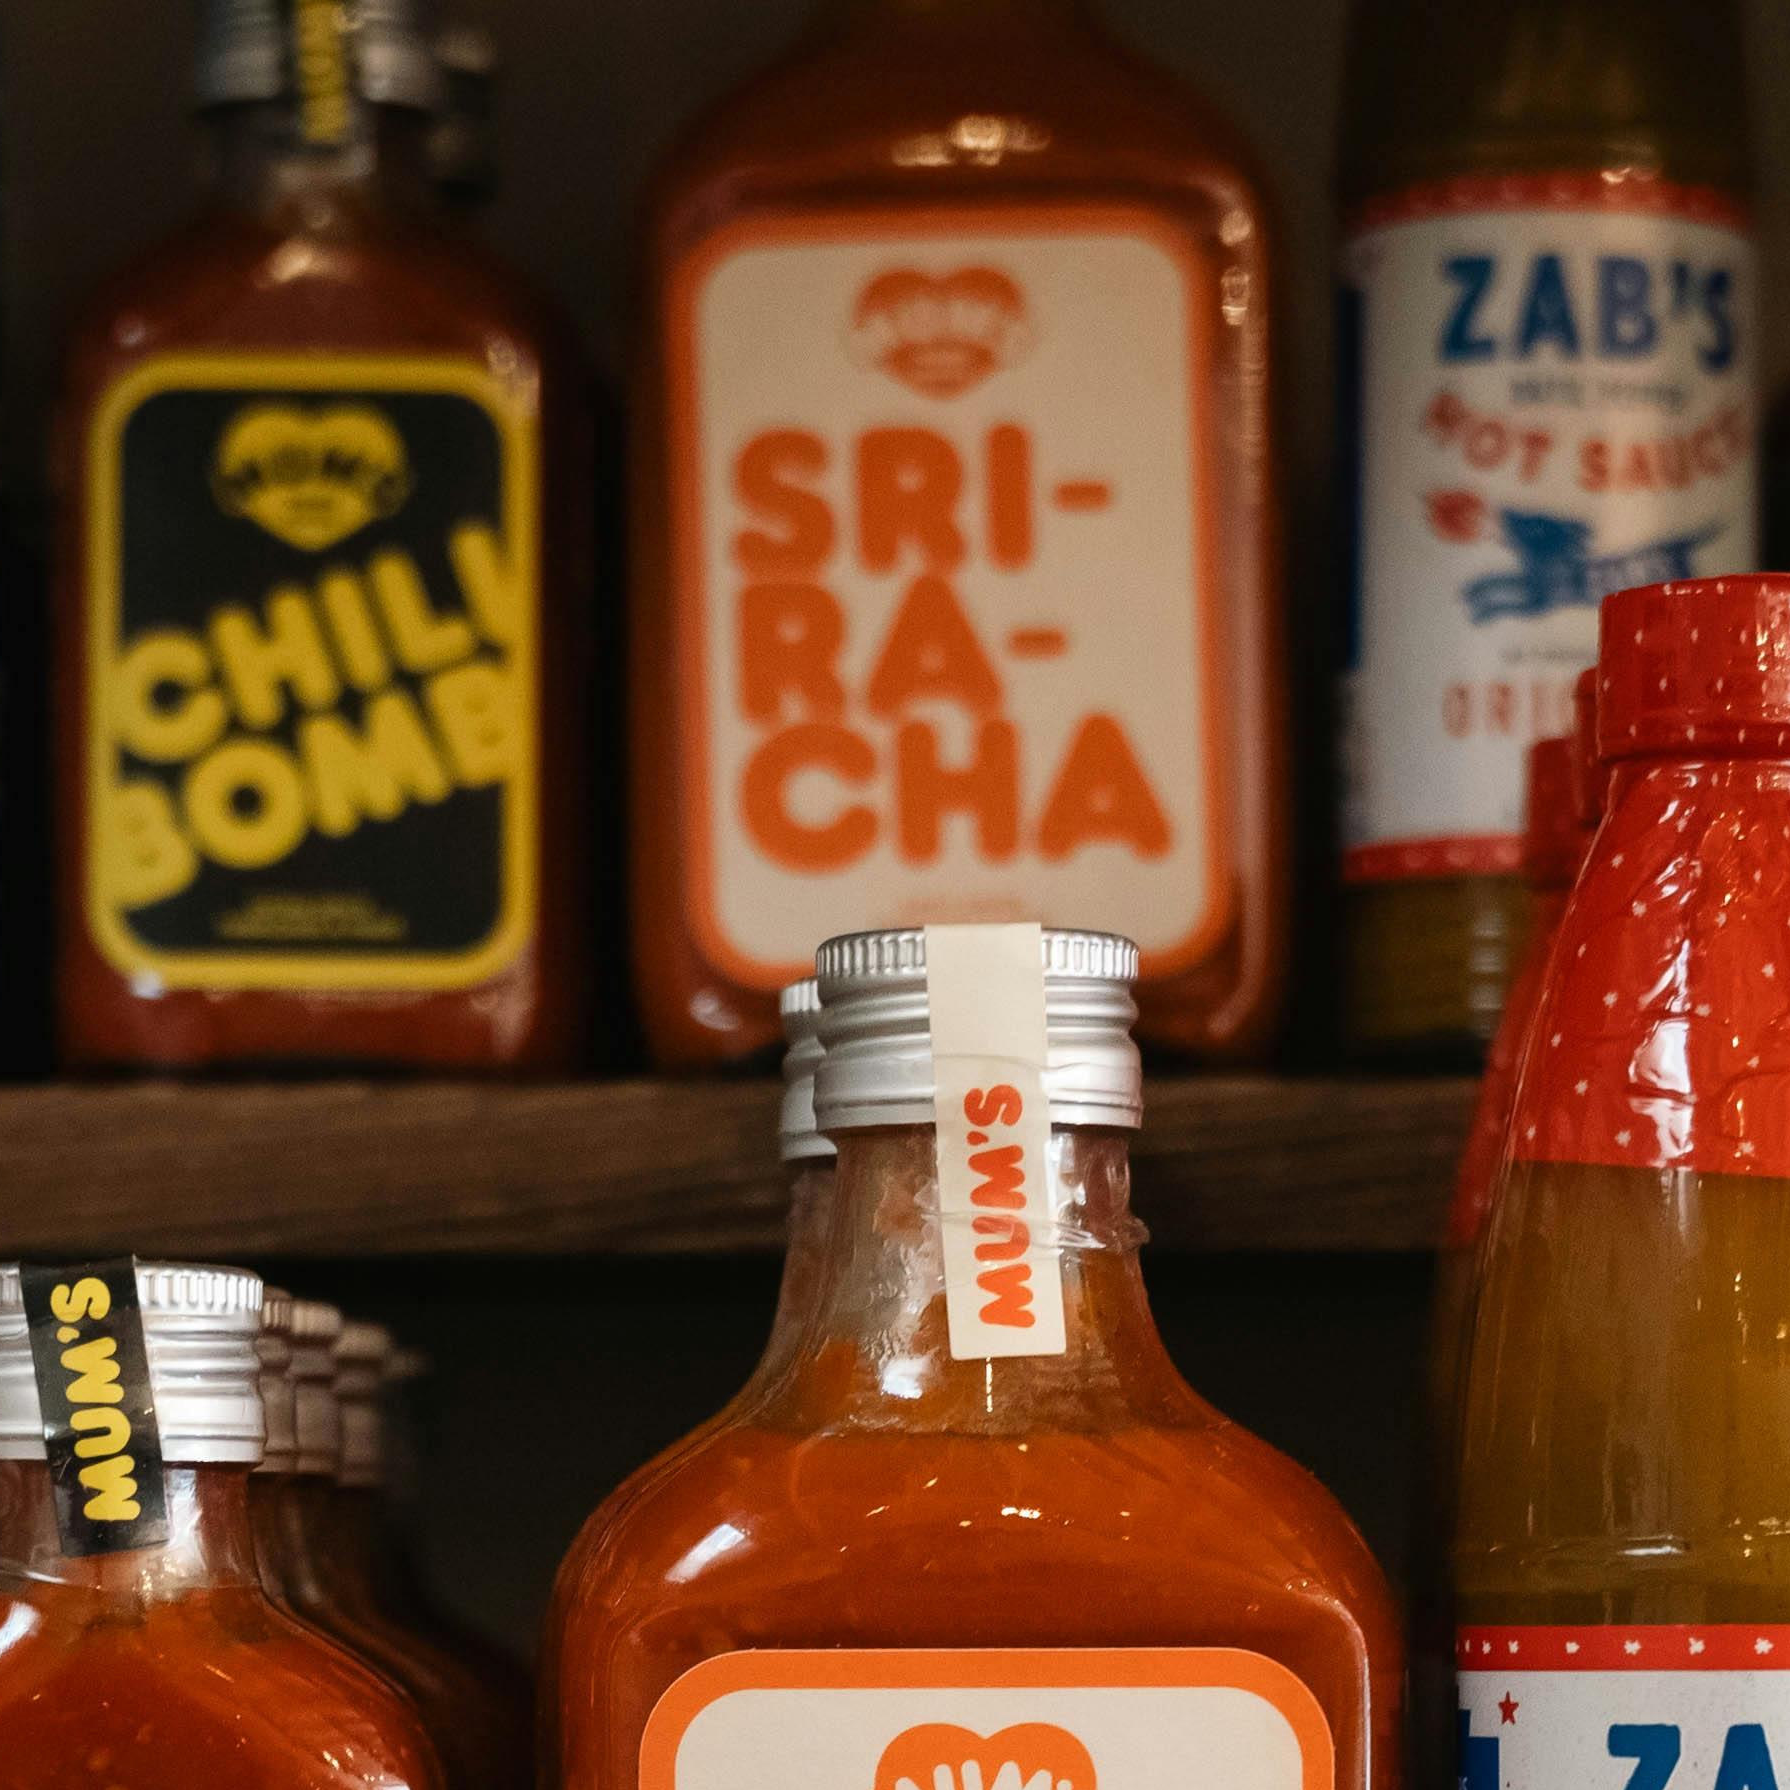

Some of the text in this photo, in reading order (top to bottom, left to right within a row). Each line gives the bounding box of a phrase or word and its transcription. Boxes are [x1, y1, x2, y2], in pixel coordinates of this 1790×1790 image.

[1436, 252, 1738, 376] ZAB'S
[731, 423, 1112, 576] SRI-
[110, 522, 510, 763] CHILI
[735, 575, 1068, 724] RA-
[110, 664, 512, 910] BOMB
[740, 712, 1174, 874] CHA
[964, 1083, 1036, 1329] MUM'S
[50, 1277, 141, 1521] MUM'S
